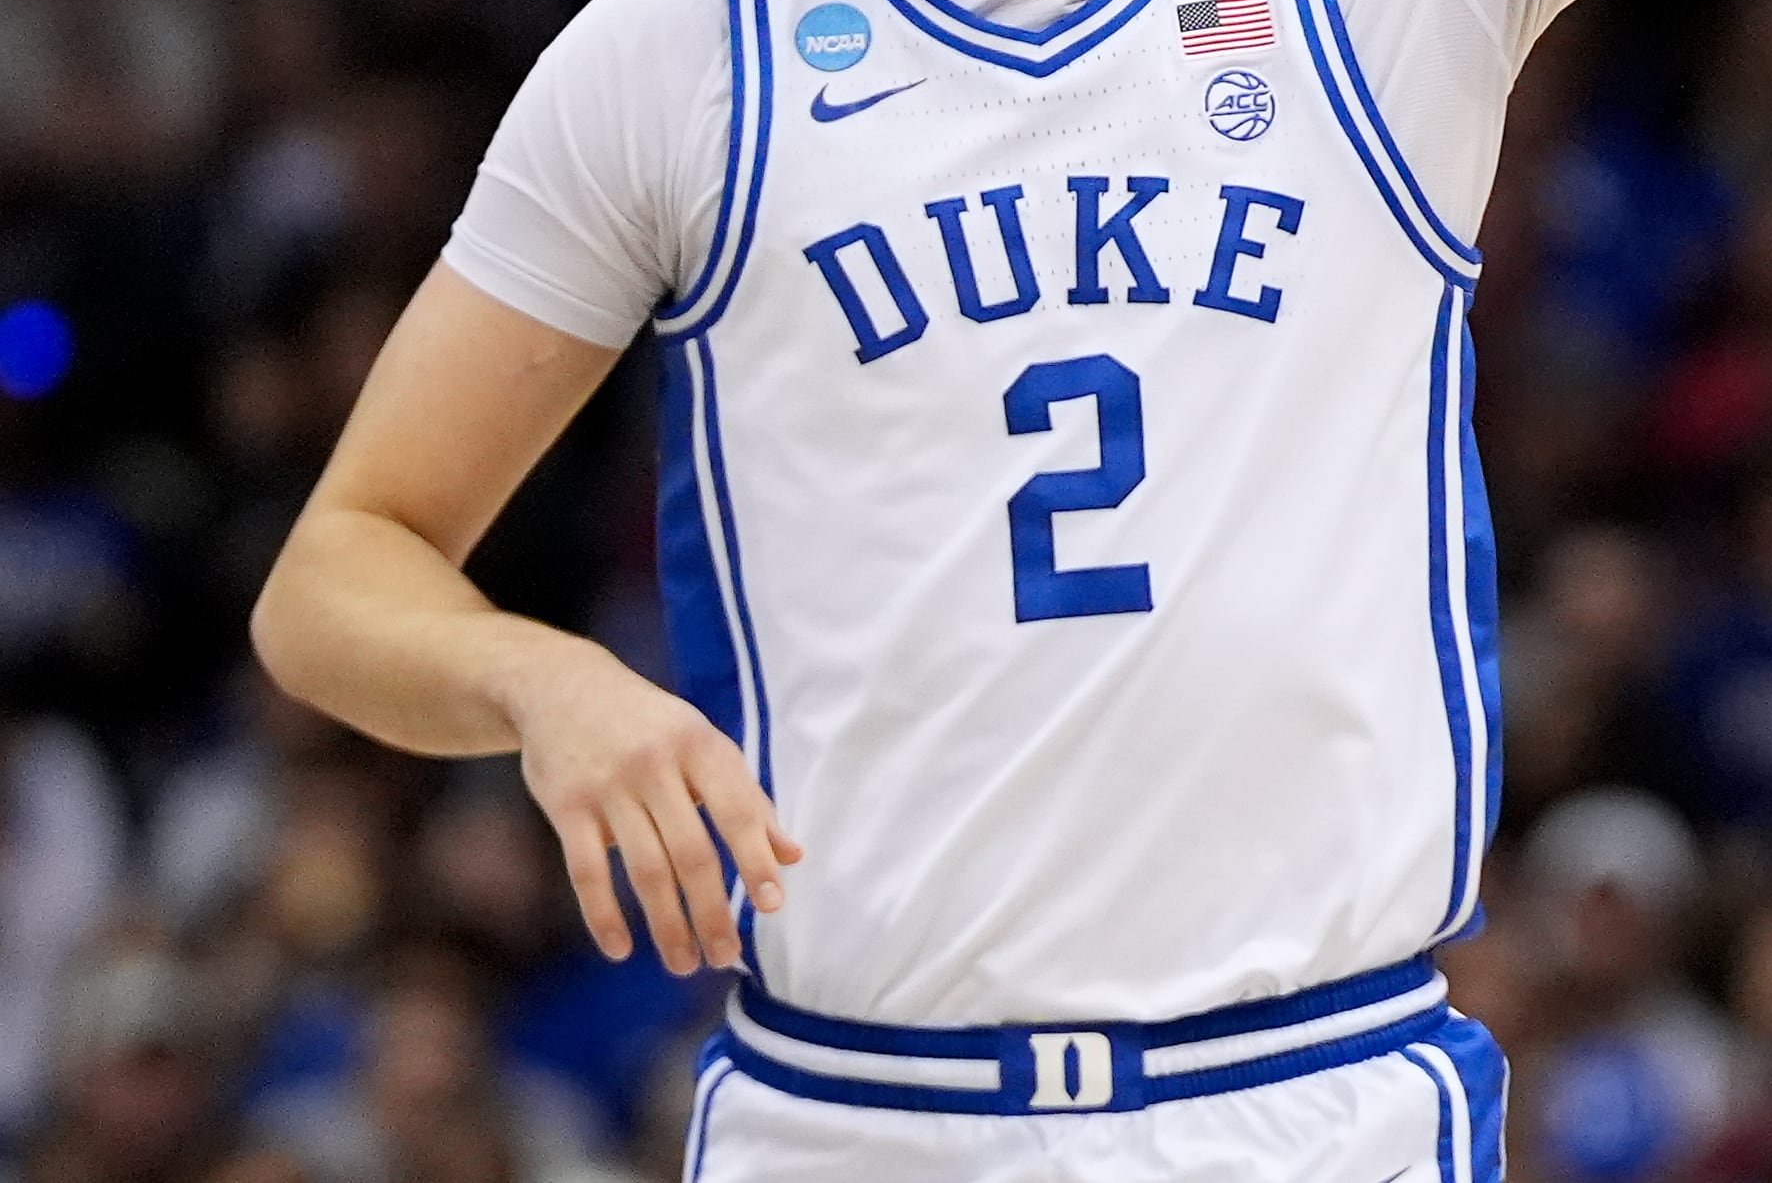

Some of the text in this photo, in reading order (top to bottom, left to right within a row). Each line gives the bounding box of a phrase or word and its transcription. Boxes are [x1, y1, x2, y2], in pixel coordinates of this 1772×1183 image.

[806, 33, 866, 54] NCAA
[1214, 91, 1269, 111] ACC
[804, 175, 1306, 363] DUKE
[1003, 353, 1154, 625] 2
[1029, 1031, 1113, 1109] D
